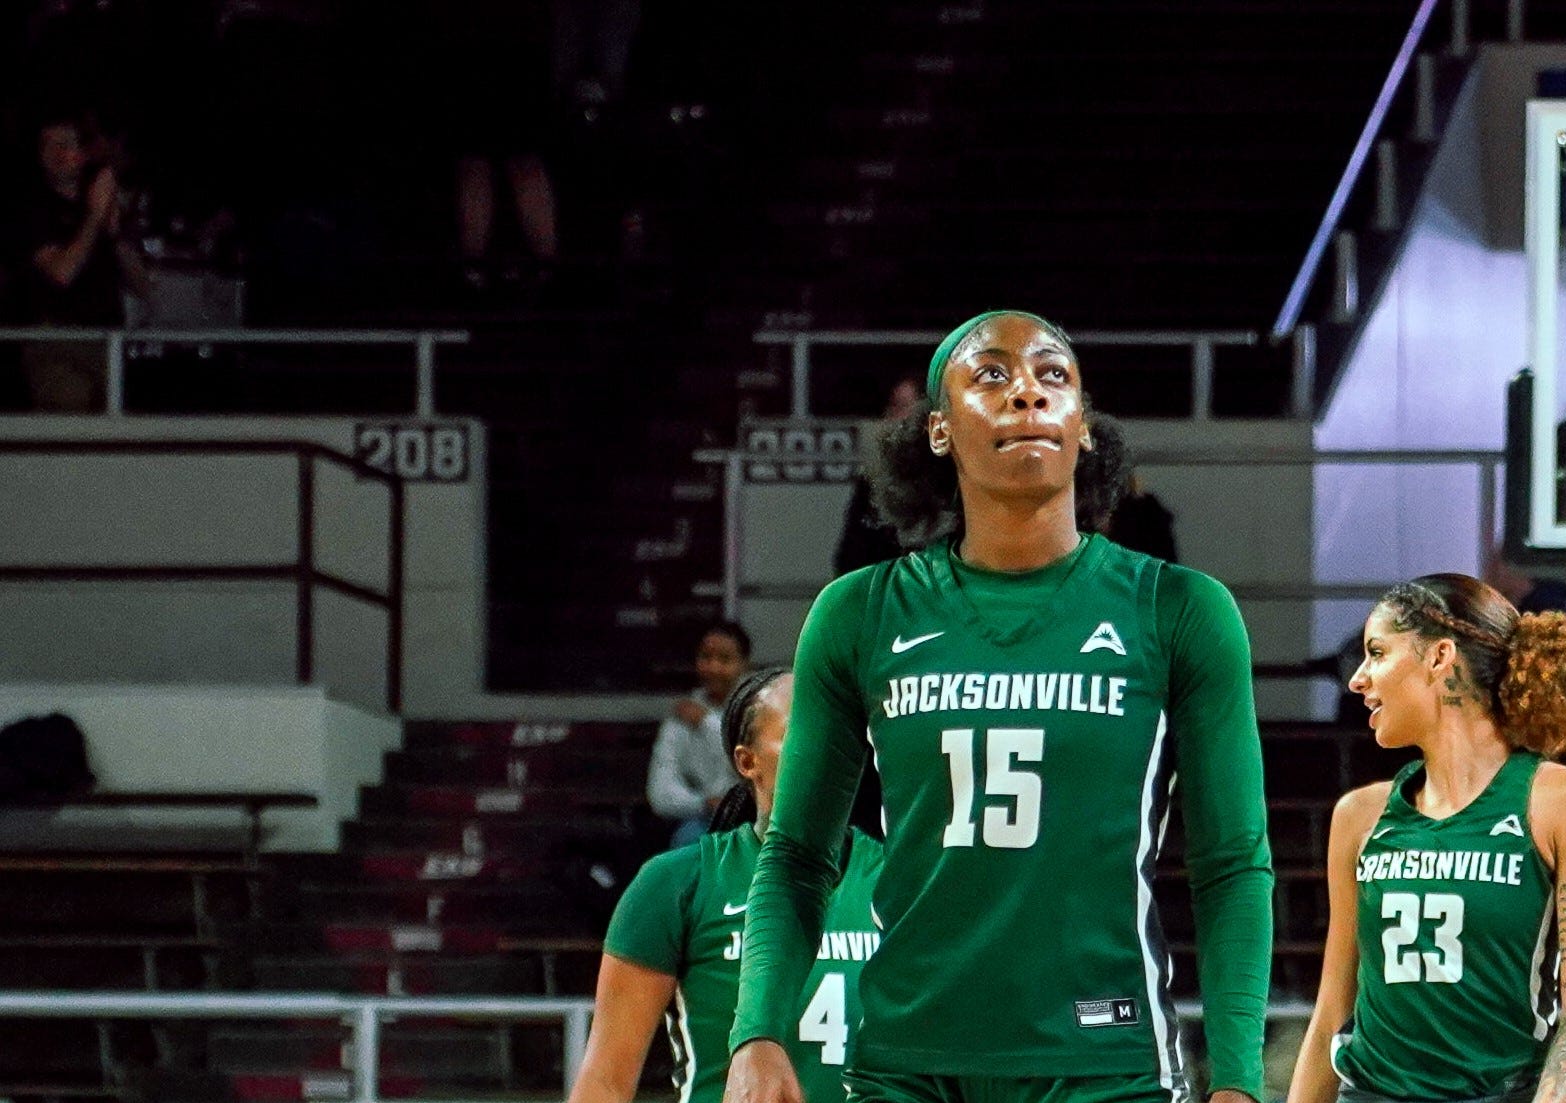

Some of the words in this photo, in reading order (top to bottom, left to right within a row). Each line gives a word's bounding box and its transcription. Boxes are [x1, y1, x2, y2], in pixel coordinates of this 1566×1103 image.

[360, 430, 464, 479] 208
[883, 672, 1127, 719] JACKSONVILLE
[941, 728, 1045, 849] 15
[1356, 850, 1524, 886] JACKSONVILLE
[1381, 892, 1465, 984] 23
[799, 973, 848, 1065] 4
[1118, 1005, 1131, 1017] M
